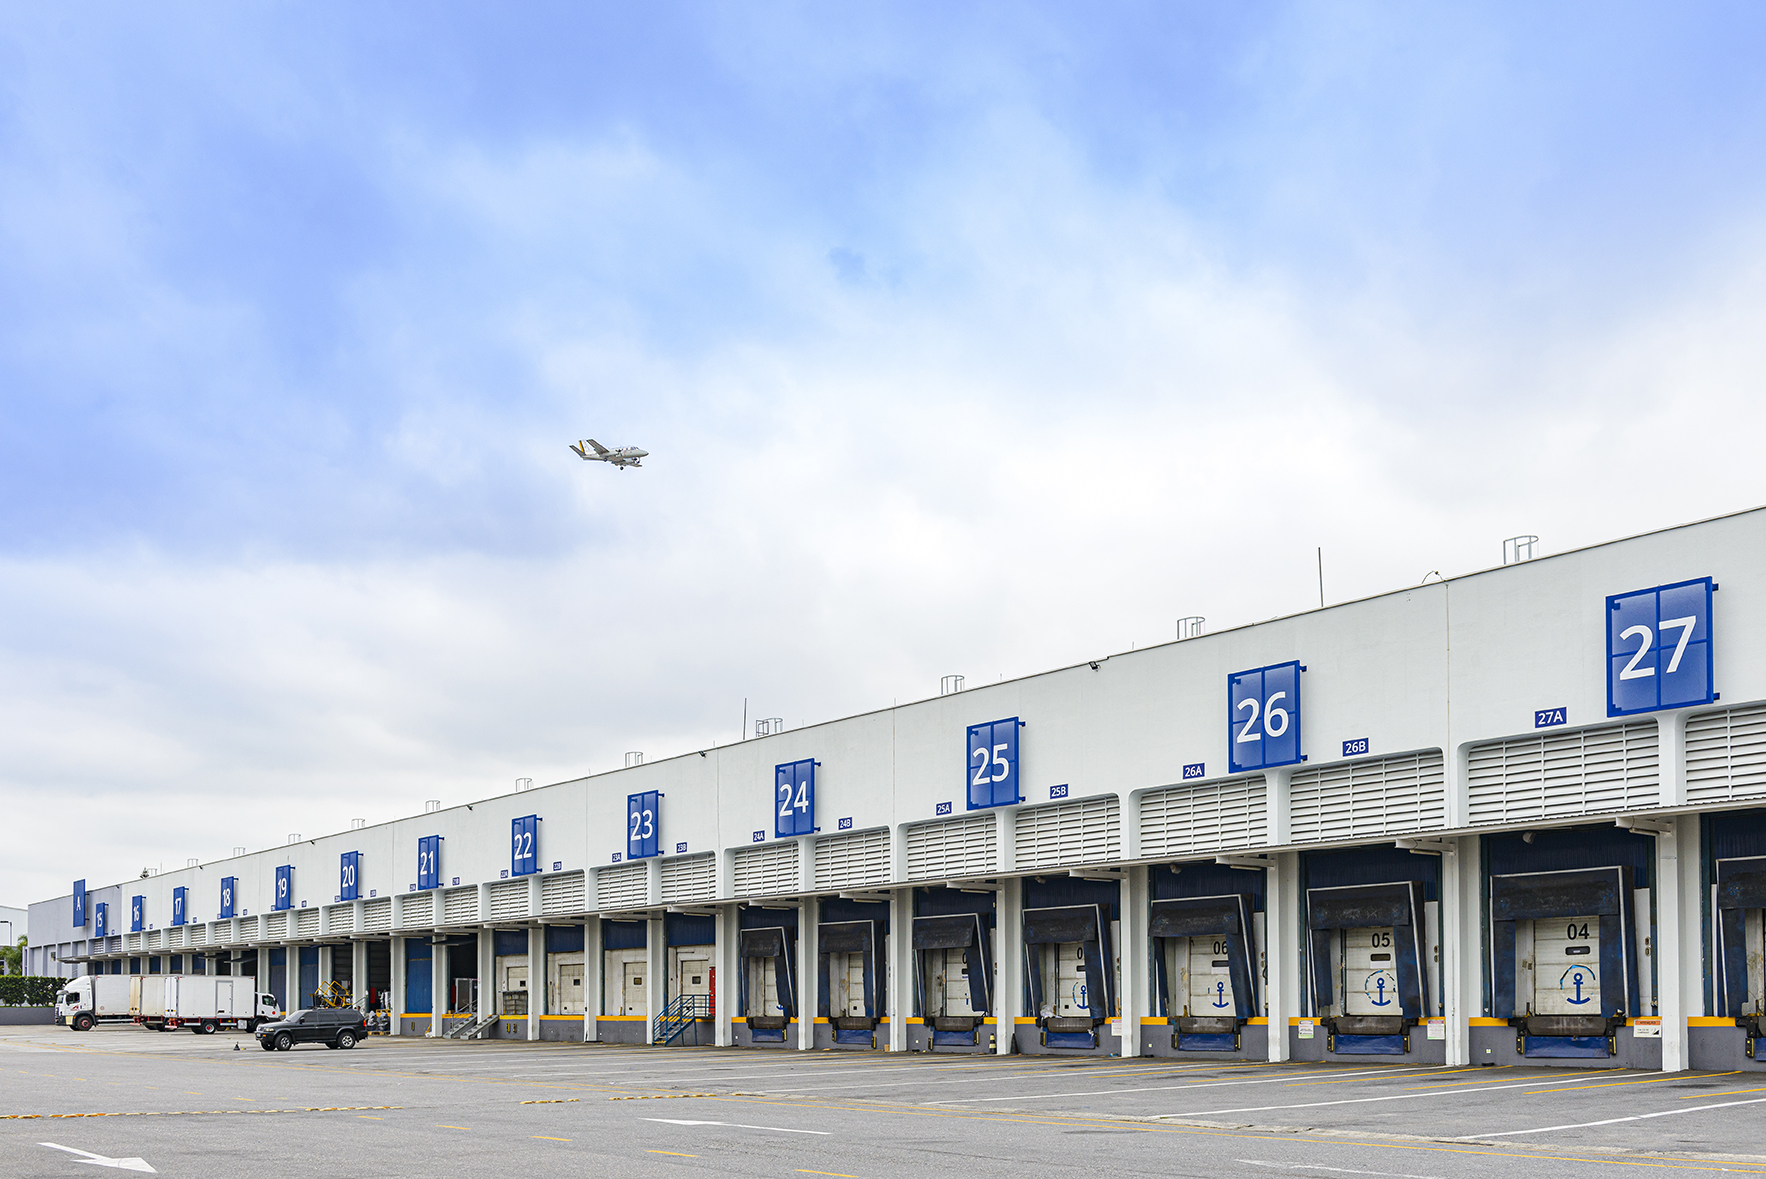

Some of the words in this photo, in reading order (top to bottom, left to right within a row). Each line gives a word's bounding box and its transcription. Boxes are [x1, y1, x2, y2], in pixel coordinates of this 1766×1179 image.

[1619, 615, 1697, 681] 27
[1235, 691, 1289, 744] 26
[1538, 710, 1563, 725] 27A
[1345, 740, 1365, 754] 26B
[971, 743, 1010, 786] 25
[1185, 765, 1203, 777] 26A
[779, 781, 809, 817] 24
[1052, 786, 1067, 797] 25B
[937, 803, 951, 814] 25A
[630, 809, 653, 841] 23
[840, 818, 851, 828] 24B
[754, 832, 764, 841] 24A
[514, 832, 532, 861] 22
[677, 843, 687, 852] 23B
[419, 850, 434, 876] 21
[342, 864, 355, 888] 20
[278, 877, 287, 898] 19
[76, 896, 81, 911] A
[222, 888, 231, 907] 18
[133, 905, 140, 922] 16
[175, 897, 182, 915] 17
[97, 912, 102, 928] 15
[1567, 923, 1590, 940] 04
[1213, 941, 1228, 955] 06
[1371, 932, 1391, 948] 05
[1076, 947, 1083, 960] 0
